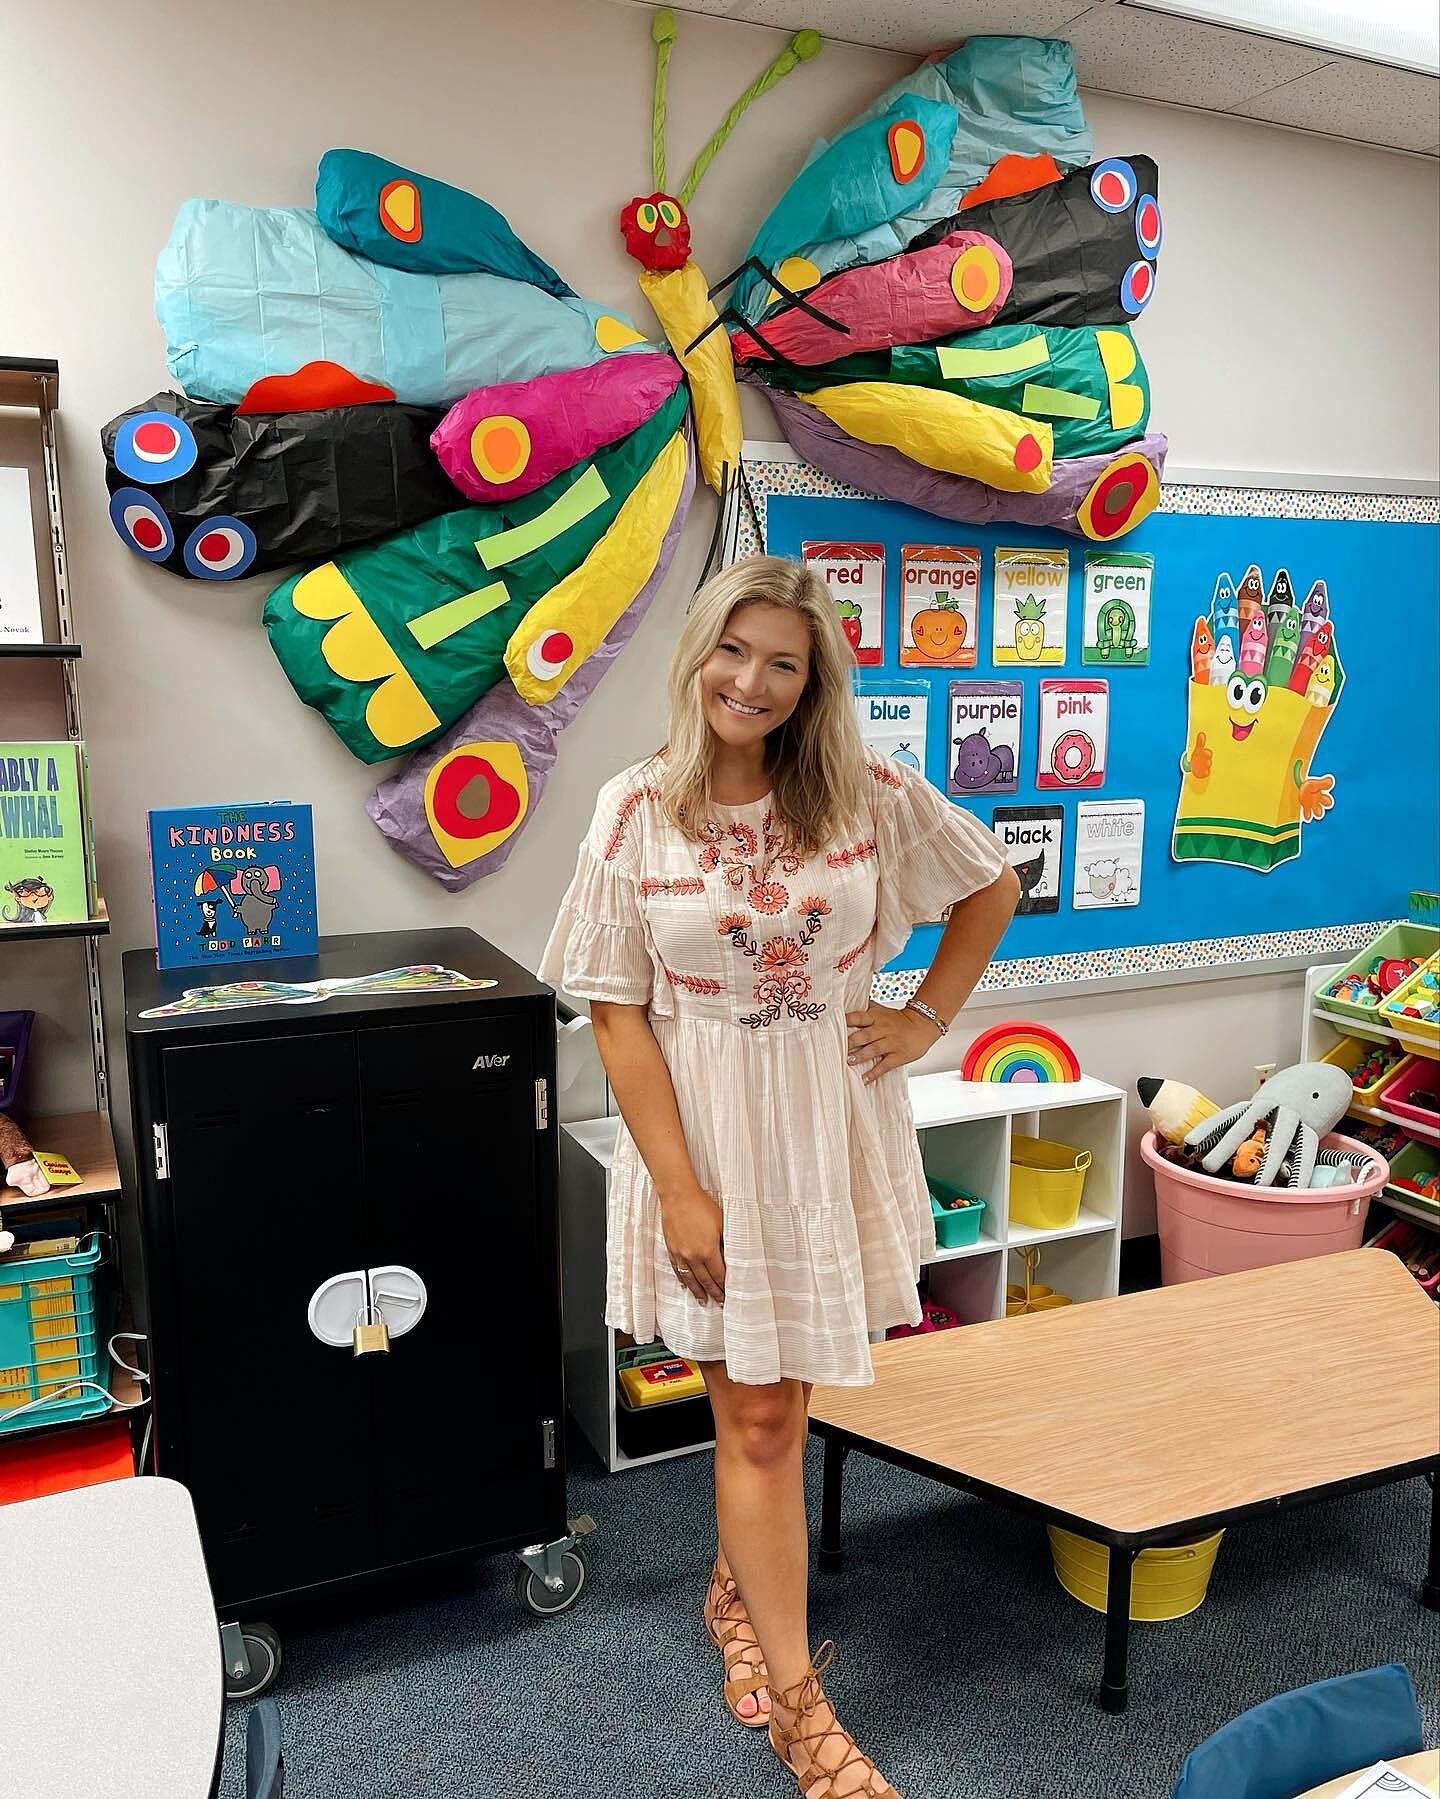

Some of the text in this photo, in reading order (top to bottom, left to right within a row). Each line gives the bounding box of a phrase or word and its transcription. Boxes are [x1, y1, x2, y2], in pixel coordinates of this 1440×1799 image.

[826, 563, 864, 585] red
[905, 567, 977, 589] orange
[1004, 566, 1064, 590] yellow
[1093, 571, 1146, 594] green
[869, 701, 911, 721] blue
[956, 699, 1018, 724] purple
[1057, 696, 1093, 719] pink
[47, 757, 59, 792] A
[0, 795, 64, 838] WHAL
[217, 810, 248, 824] THE
[1087, 816, 1135, 839] white
[169, 820, 296, 848] KINDNESS
[1004, 825, 1053, 845] black
[210, 846, 257, 862] BOOK
[199, 935, 281, 952] TODD PARR
[472, 1054, 511, 1070] AVer
